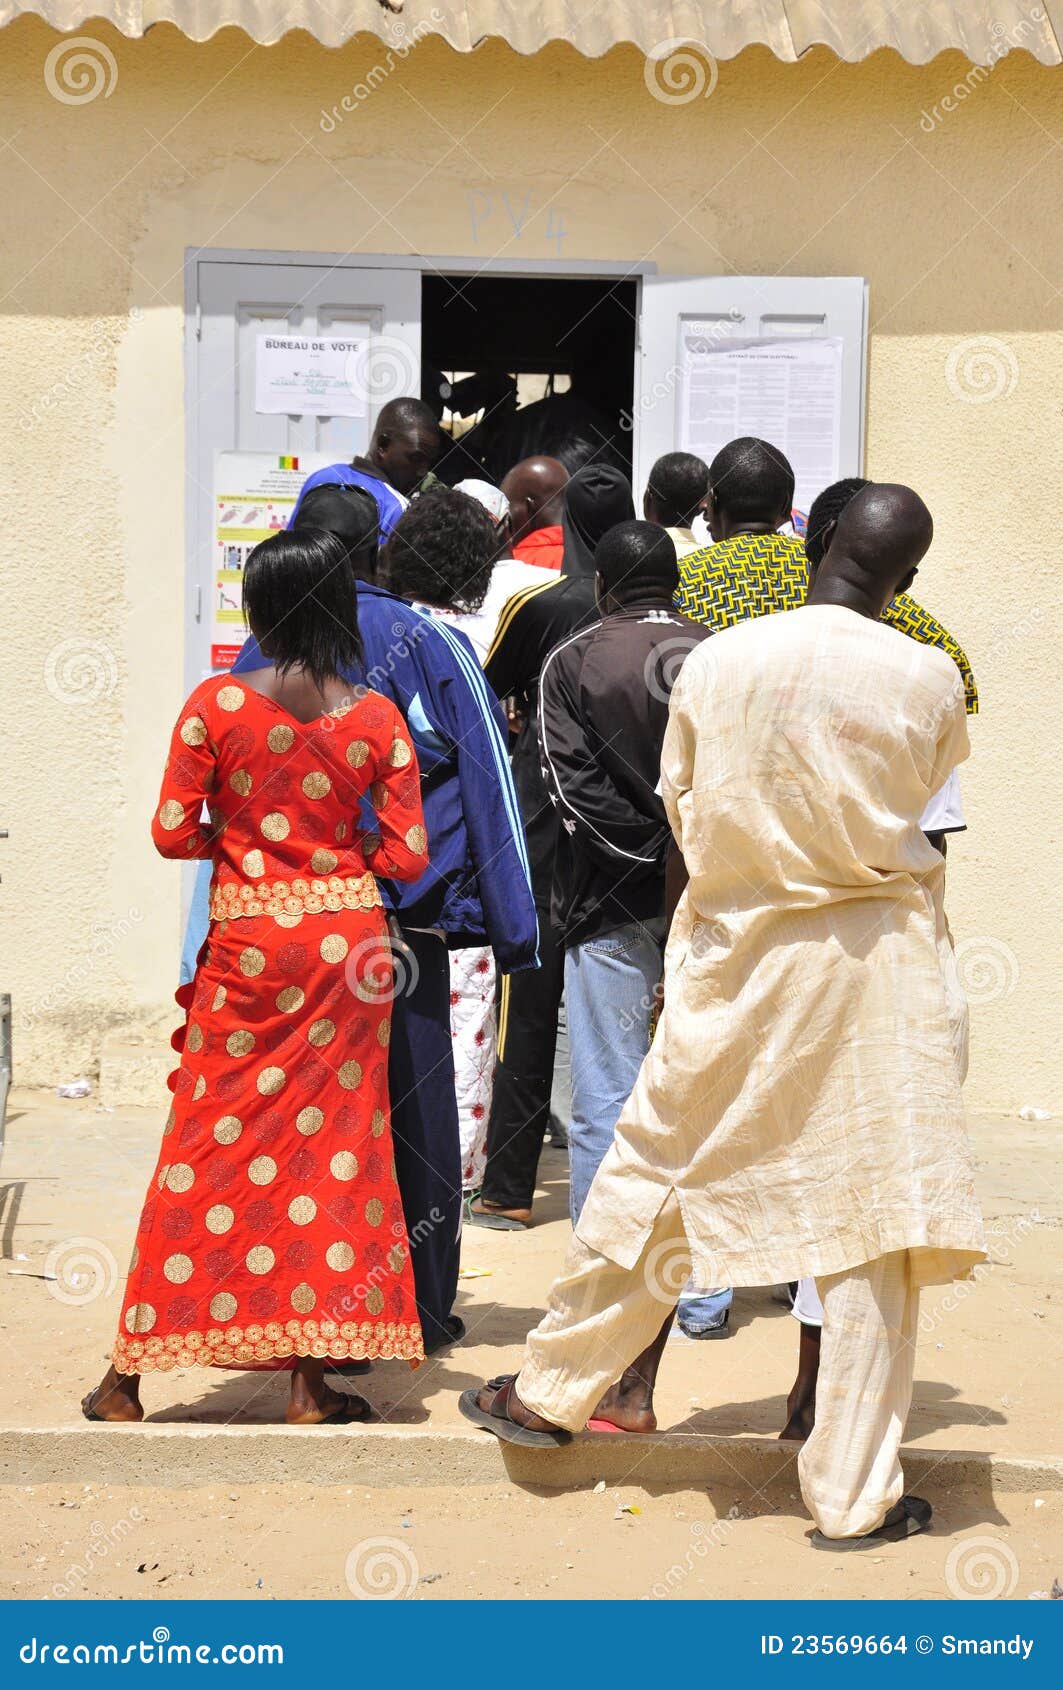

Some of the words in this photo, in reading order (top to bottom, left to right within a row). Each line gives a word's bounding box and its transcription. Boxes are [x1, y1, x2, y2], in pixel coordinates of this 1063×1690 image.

[265, 340, 308, 351] BUREAU
[312, 343, 325, 351] DE
[331, 343, 360, 352] VOTE
